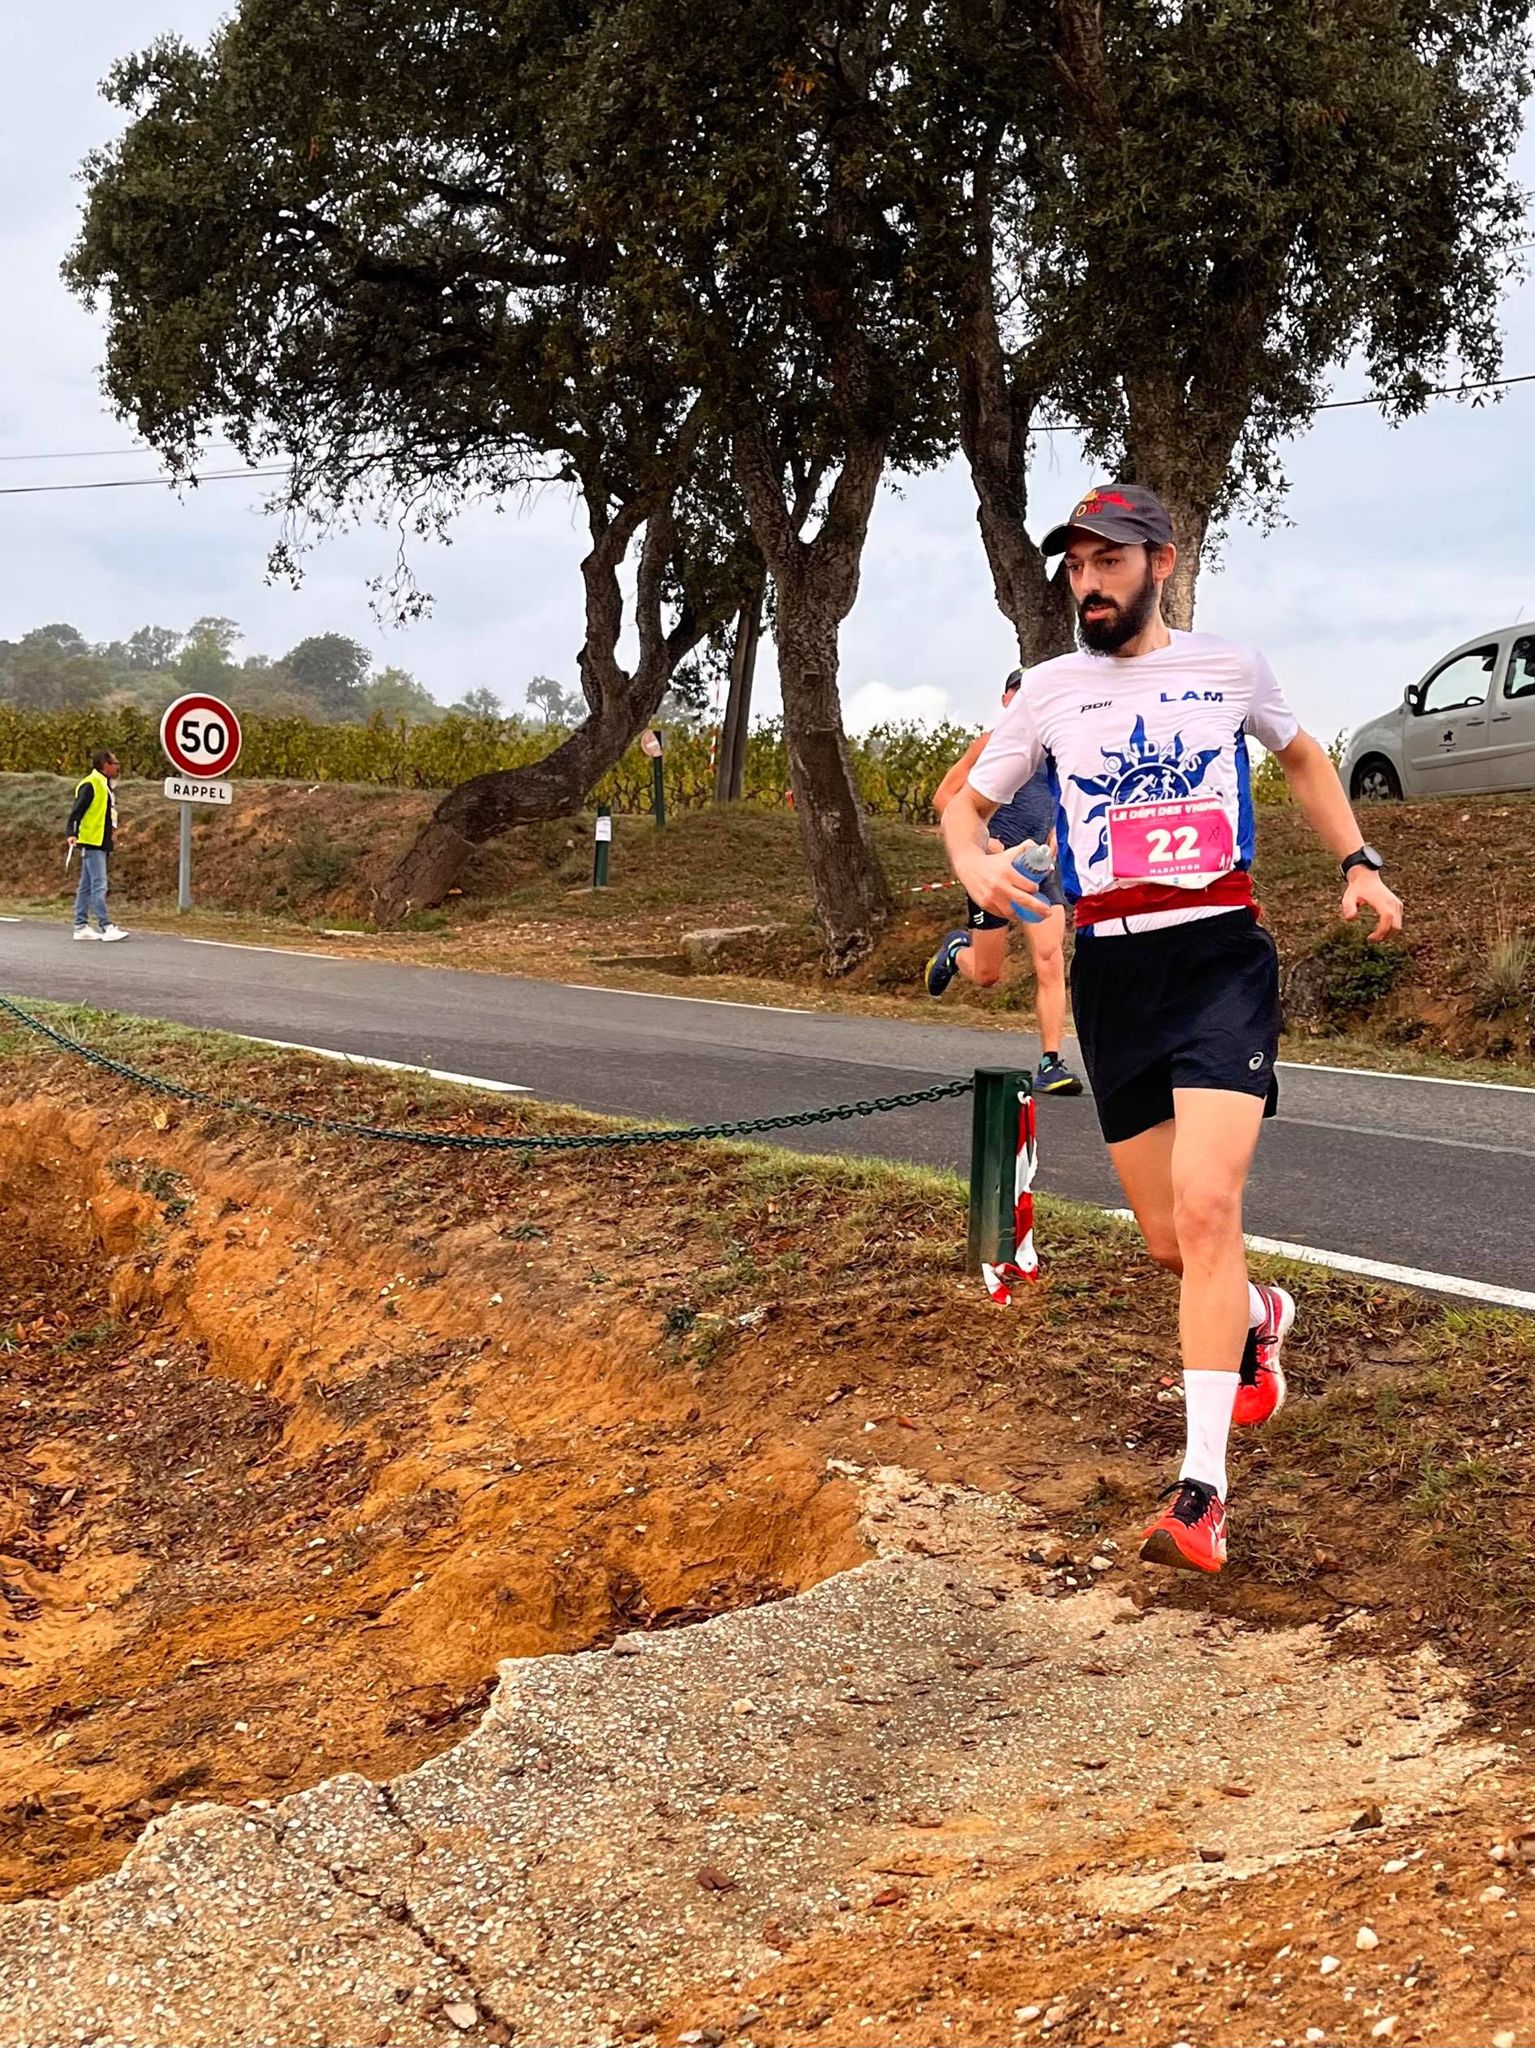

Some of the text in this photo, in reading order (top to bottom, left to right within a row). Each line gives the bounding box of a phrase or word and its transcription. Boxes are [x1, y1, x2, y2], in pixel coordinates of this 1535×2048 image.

[1160, 691, 1224, 702] LAM
[180, 720, 225, 755] 50
[1092, 739, 1202, 789] LONDAIS
[173, 784, 226, 799] RAPPEL
[1112, 811, 1127, 822] LE
[1157, 804, 1182, 816] DES
[1145, 826, 1201, 863] 22
[1149, 863, 1200, 874] MARATHON
